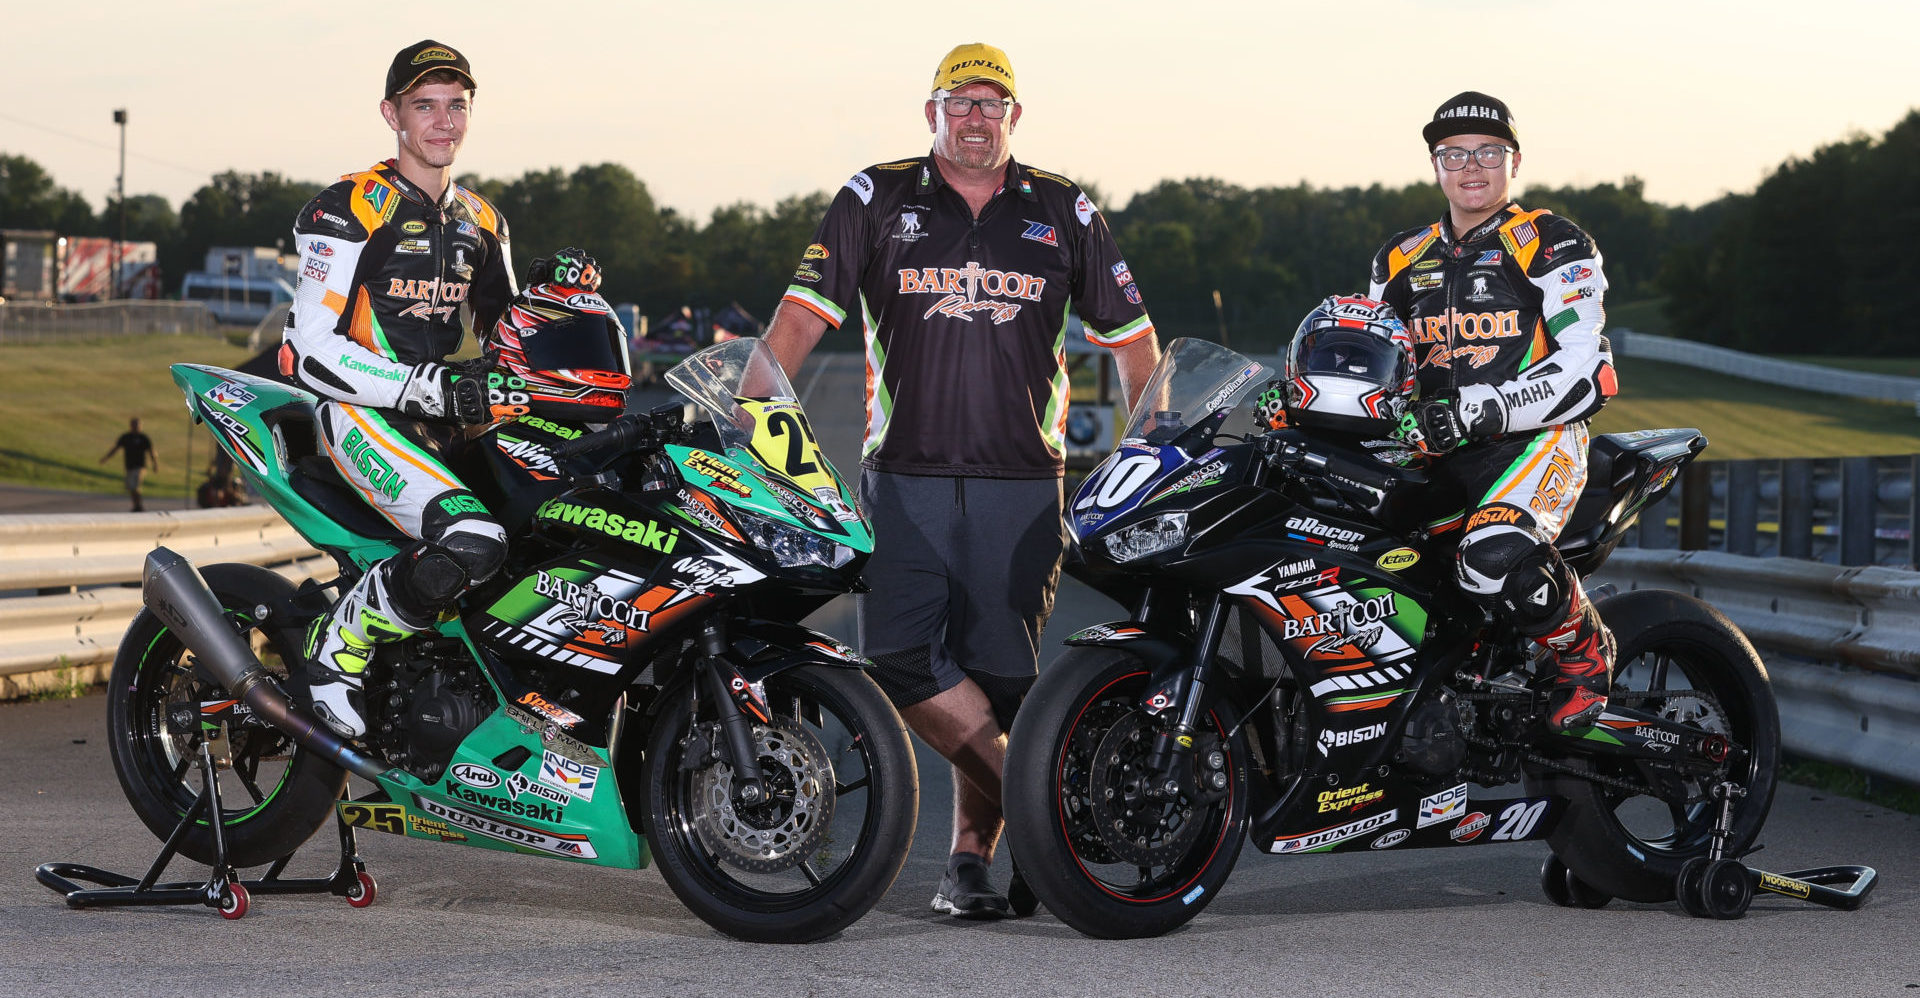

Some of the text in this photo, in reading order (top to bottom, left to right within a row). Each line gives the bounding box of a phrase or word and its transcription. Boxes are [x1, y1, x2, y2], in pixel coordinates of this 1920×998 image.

[950, 59, 1012, 79] DUNLOP
[1440, 105, 1499, 120] YAMAHA
[322, 212, 349, 227] BISON
[311, 241, 328, 254] VP
[1553, 239, 1577, 251] BISON
[1340, 304, 1374, 318] Arai
[338, 354, 407, 382] Kawasaki
[217, 382, 255, 403] INDE
[1506, 380, 1556, 410] MAHA
[210, 411, 249, 435] 400
[341, 427, 408, 502] BISON
[688, 449, 744, 478] Orient
[682, 457, 754, 495] Express
[536, 498, 680, 555] Kawasaki
[1286, 517, 1365, 542] aRacer
[1465, 506, 1522, 533] BISON
[1327, 540, 1360, 552] SpeedTek
[672, 556, 735, 588] Ninja
[1277, 559, 1317, 579] YAMAHA
[531, 706, 571, 730] RACING
[1336, 722, 1387, 747] BISON
[458, 766, 494, 784] Arai
[544, 751, 598, 780] INDE
[445, 779, 563, 824] Kawasaki
[529, 783, 570, 805] BISON
[1317, 782, 1370, 803] Orient
[1318, 789, 1384, 813] Express
[1421, 785, 1466, 809] INDE
[344, 806, 404, 834] 25
[407, 814, 448, 830] Orient
[412, 822, 465, 839] Express
[426, 801, 546, 845] DUNLOP
[1305, 812, 1393, 847] DUNLOP
[1451, 816, 1490, 838] WESTBY
[1491, 800, 1548, 841] 20
[1379, 830, 1407, 845] Arai
